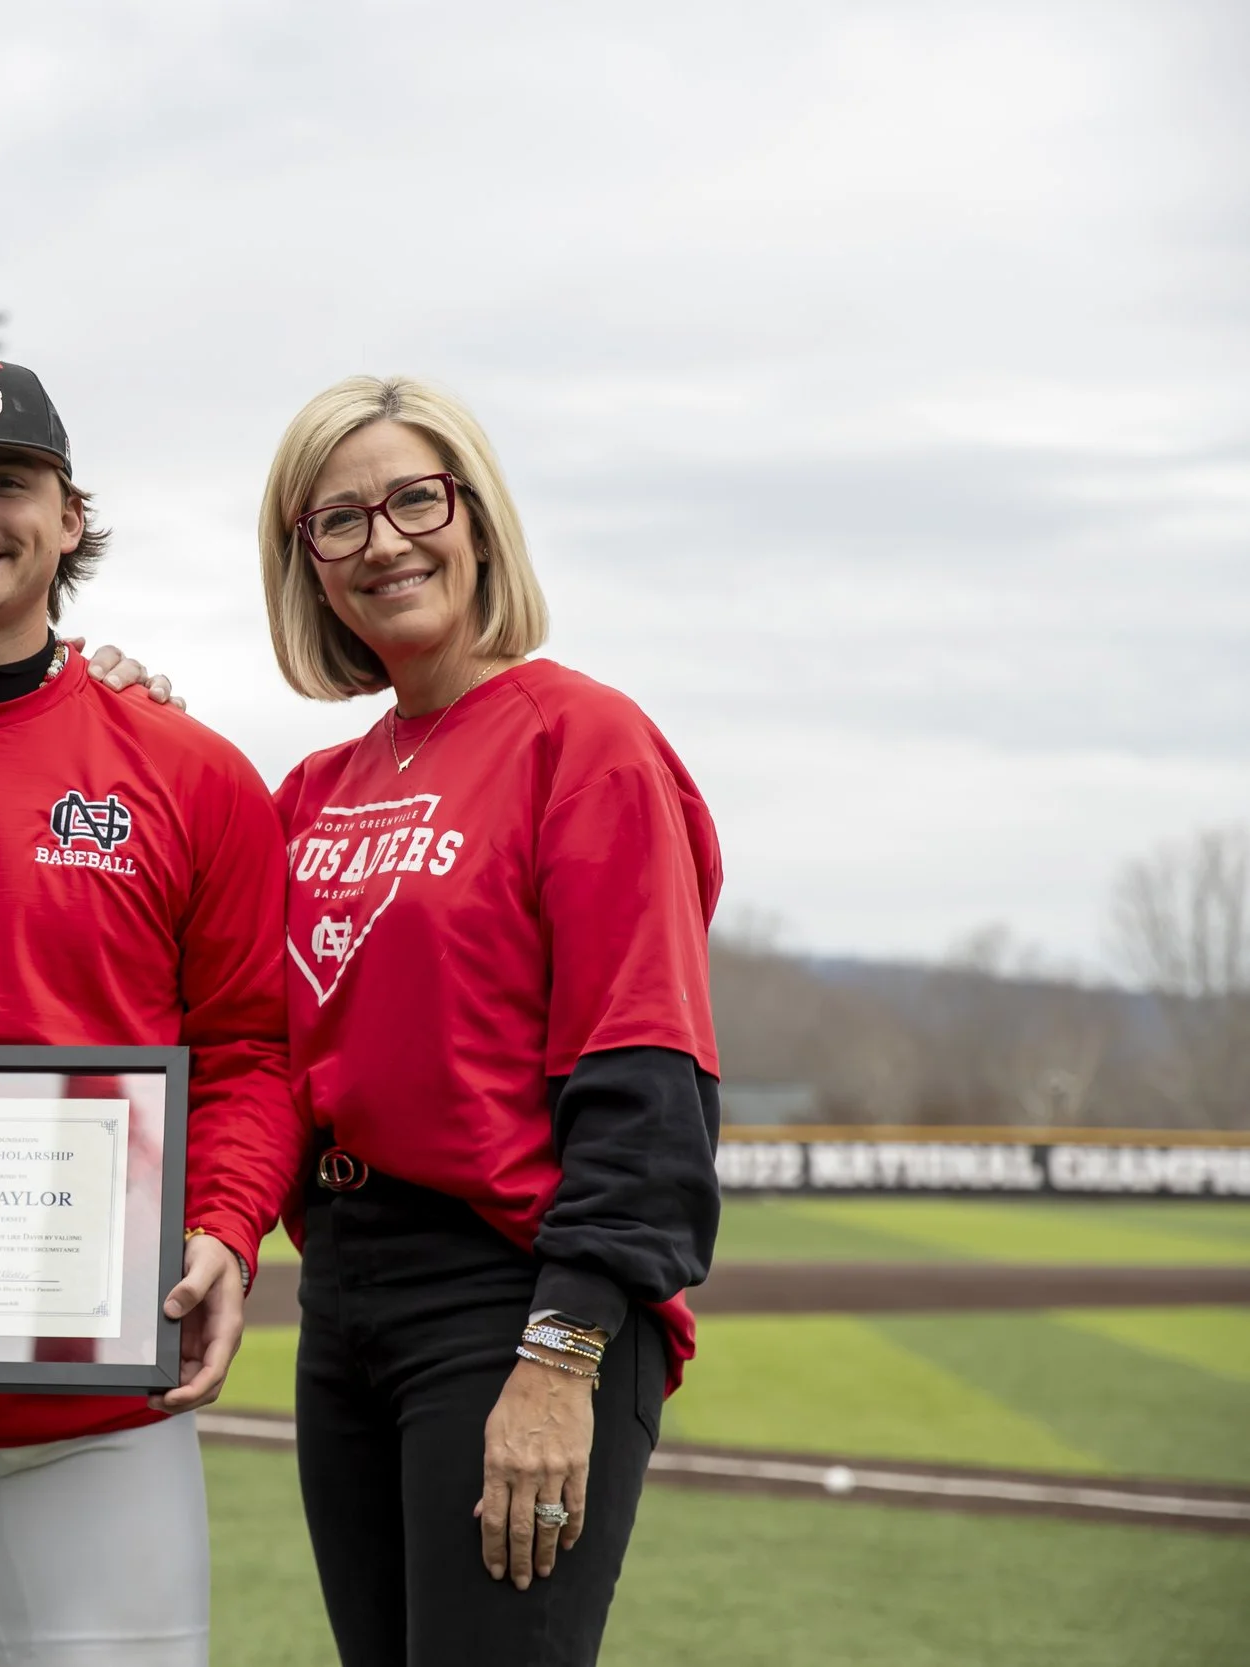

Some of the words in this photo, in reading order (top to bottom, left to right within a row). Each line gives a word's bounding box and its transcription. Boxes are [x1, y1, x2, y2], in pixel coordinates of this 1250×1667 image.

[314, 821, 356, 833] NORTH
[359, 810, 419, 829] GREENVILLE
[35, 846, 136, 876] BASEBALL
[313, 886, 365, 900] BASEBALL
[808, 1142, 1045, 1190] NATIONAL
